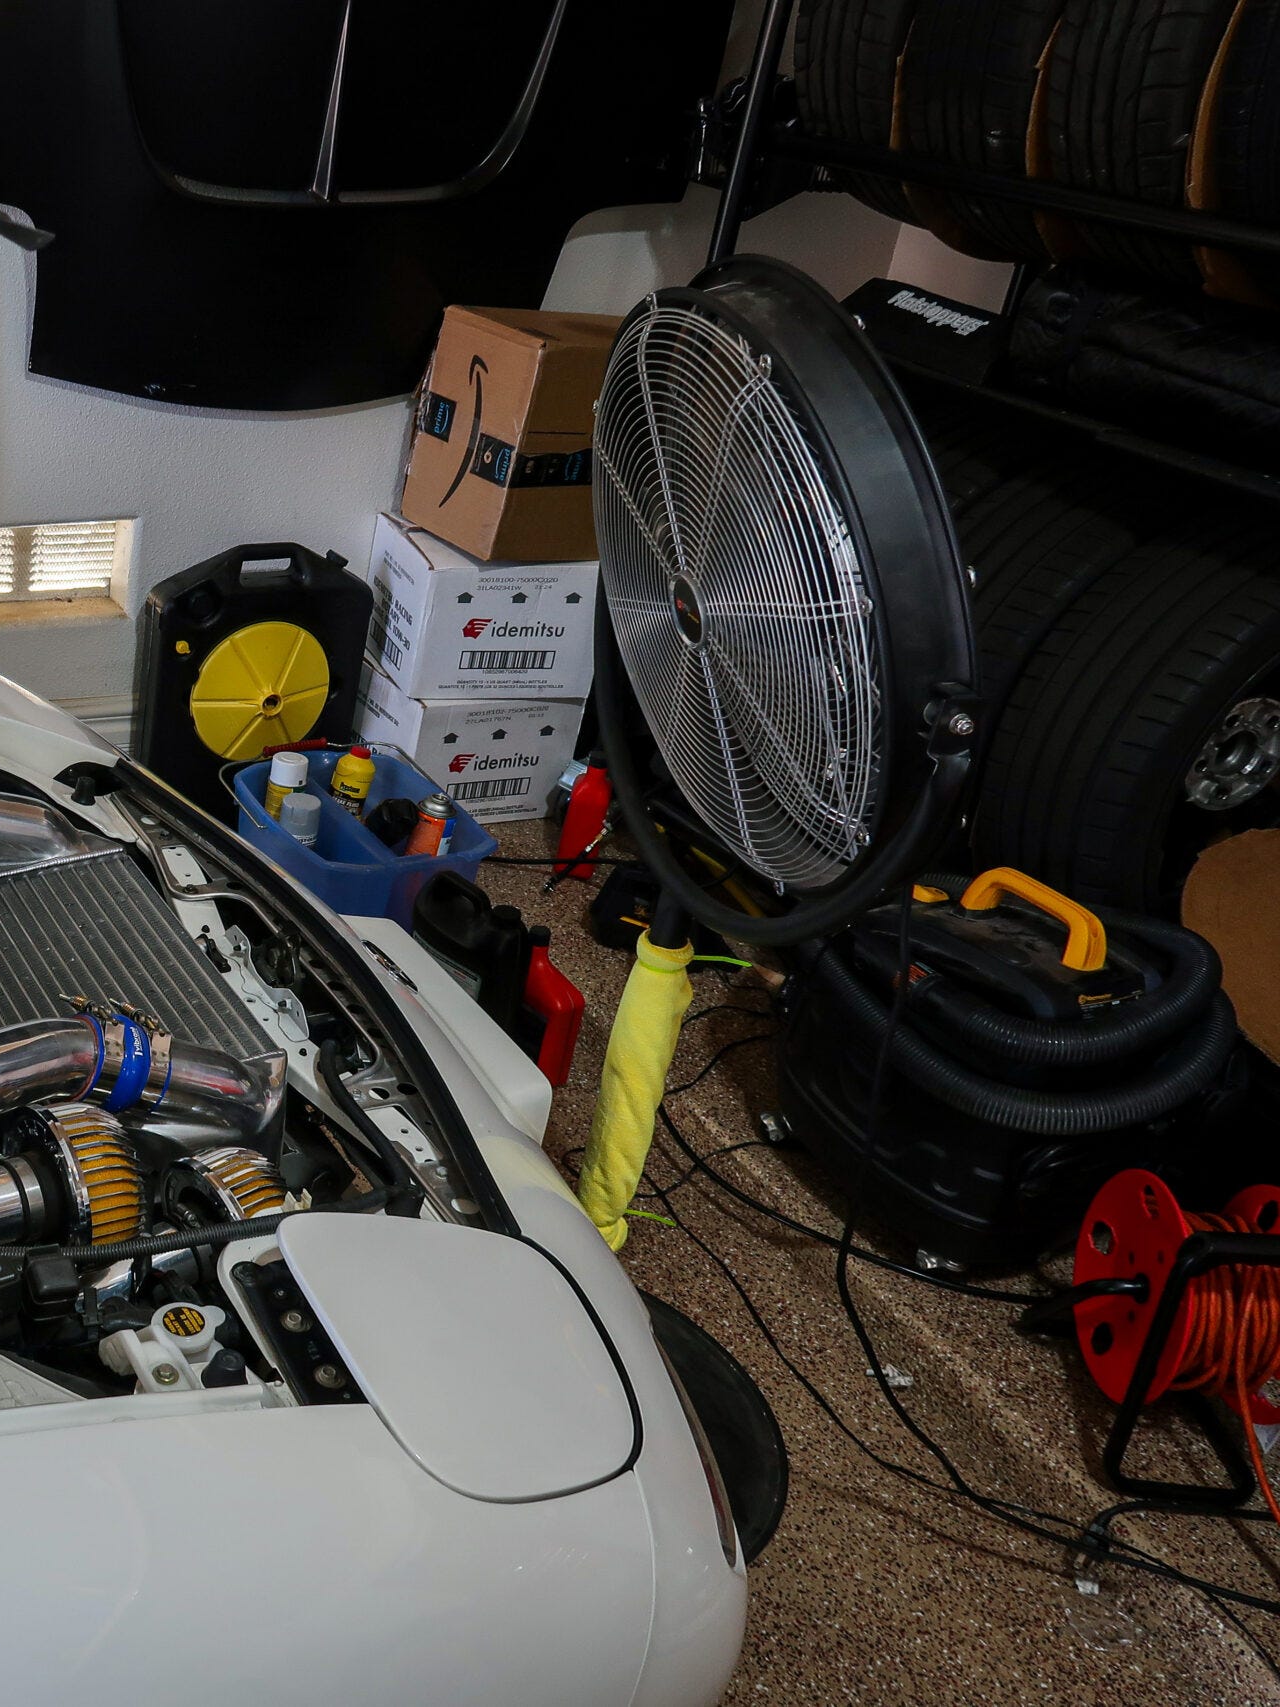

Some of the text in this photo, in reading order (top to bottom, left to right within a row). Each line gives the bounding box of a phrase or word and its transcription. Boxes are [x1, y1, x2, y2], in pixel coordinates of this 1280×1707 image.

[434, 401, 446, 434] prime
[498, 448, 511, 481] prime
[490, 621, 565, 638] idemitsu
[473, 753, 540, 772] idemitsu
